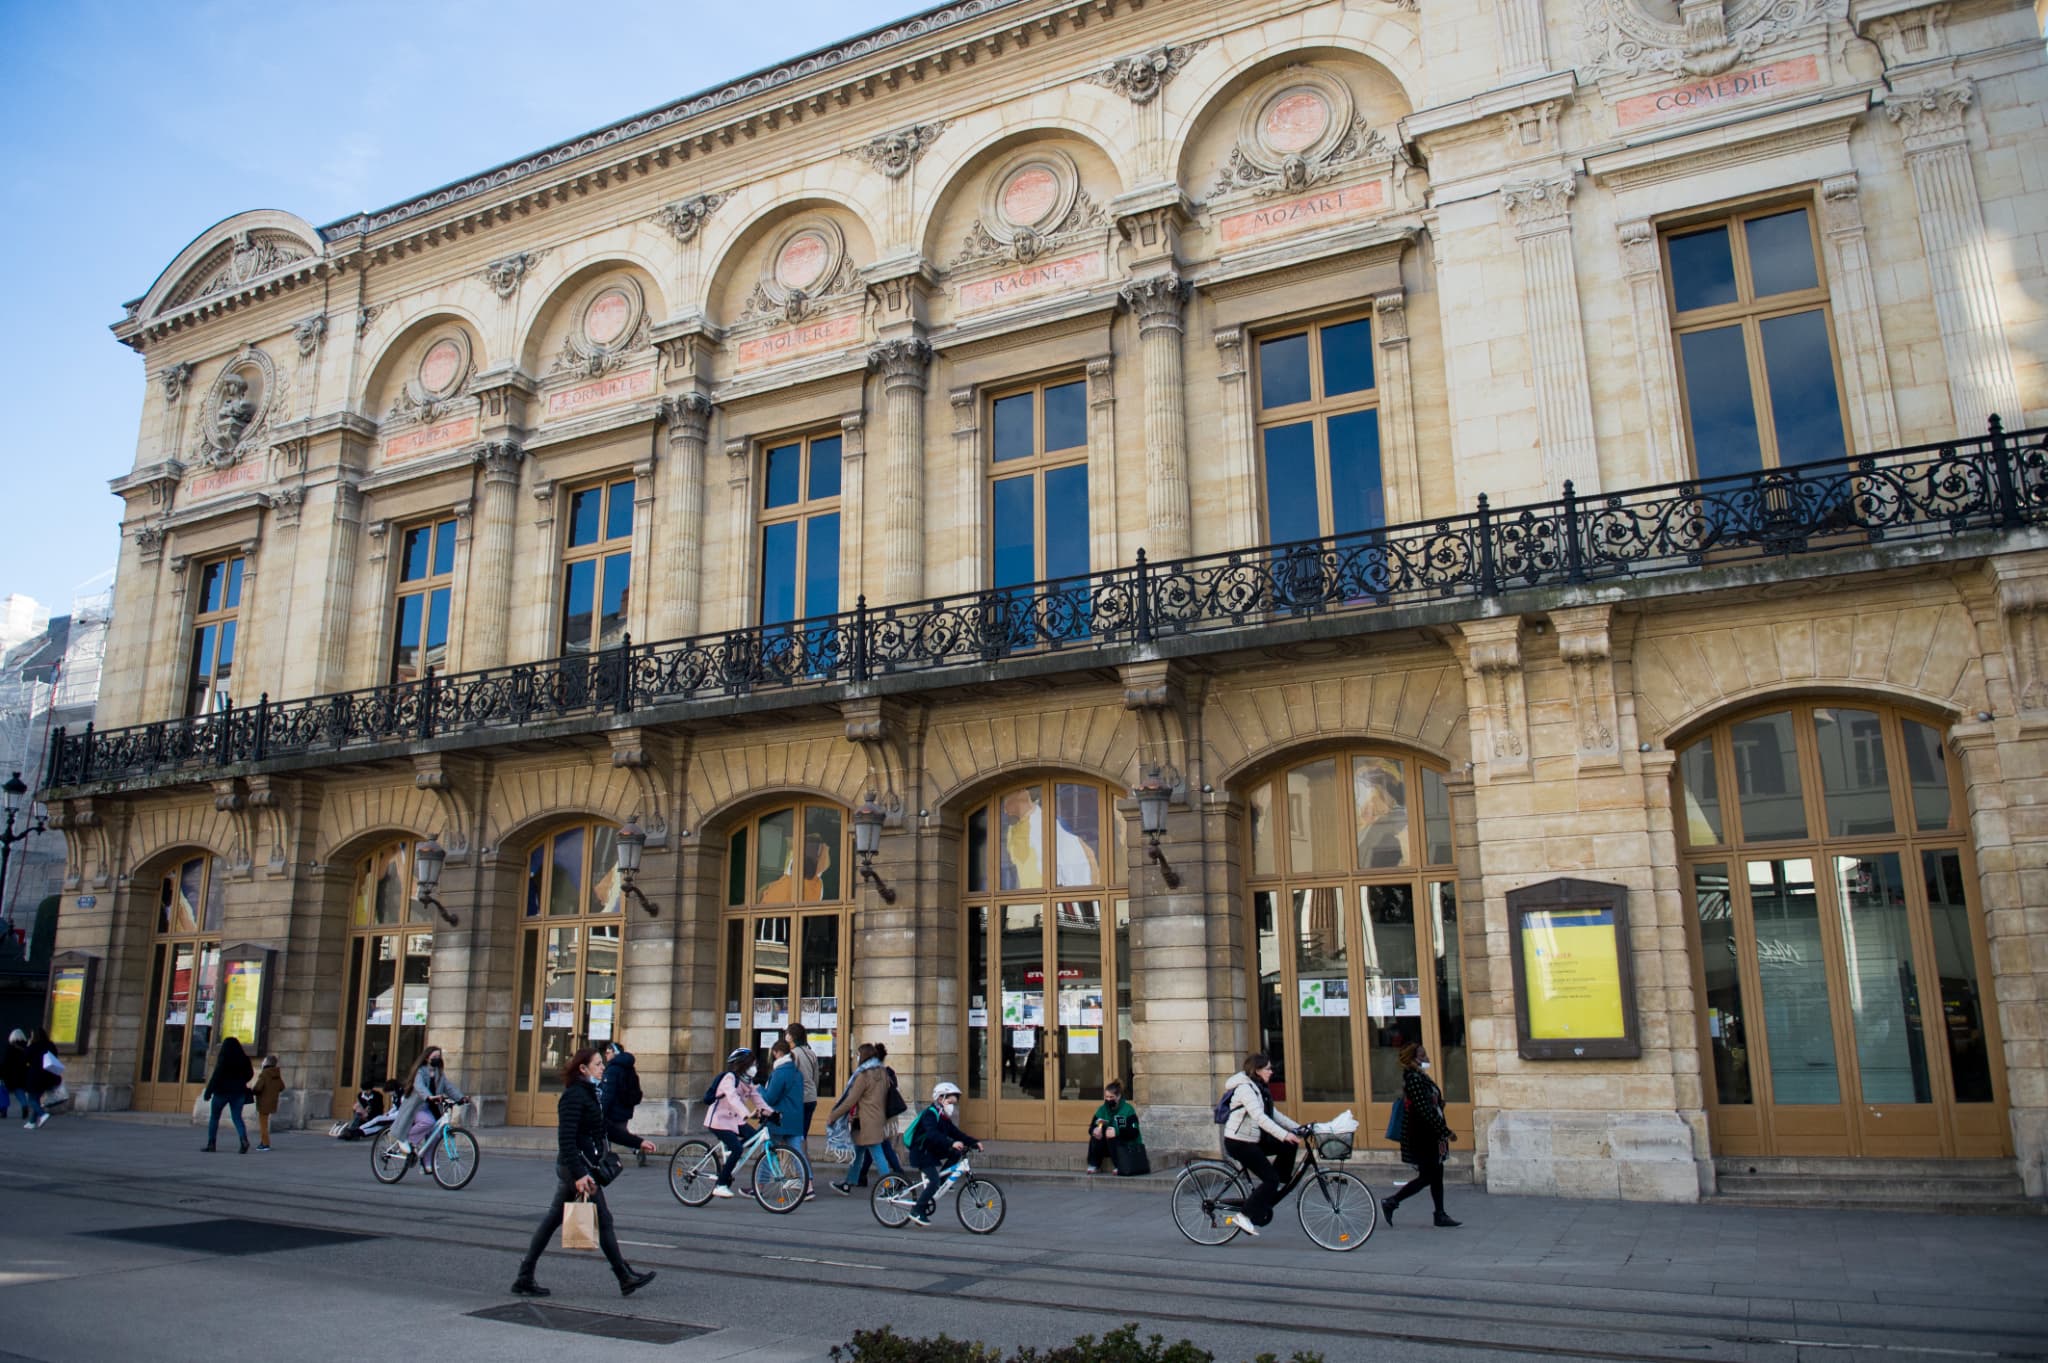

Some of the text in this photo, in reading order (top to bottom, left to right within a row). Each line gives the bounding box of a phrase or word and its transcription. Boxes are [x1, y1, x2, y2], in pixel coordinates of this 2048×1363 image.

[1655, 70, 1777, 112] COMEDIE
[1253, 192, 1347, 228] MOZART
[993, 266, 1065, 295] RACINE
